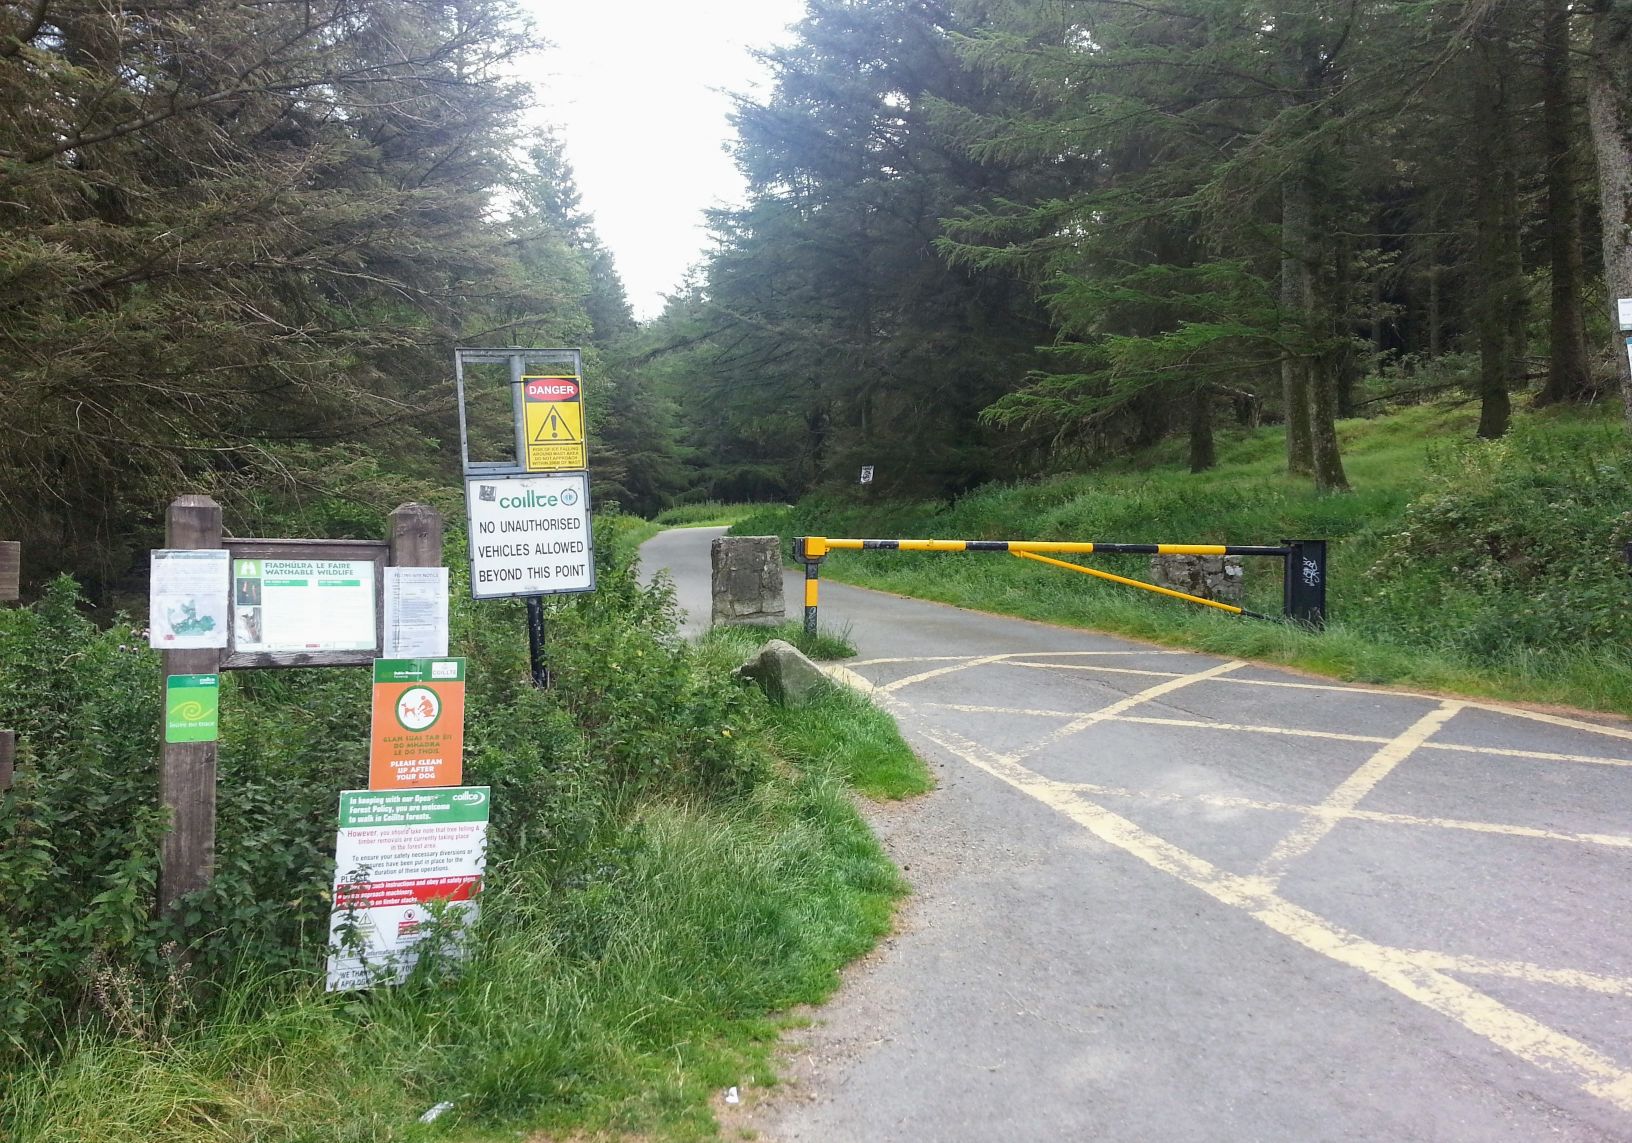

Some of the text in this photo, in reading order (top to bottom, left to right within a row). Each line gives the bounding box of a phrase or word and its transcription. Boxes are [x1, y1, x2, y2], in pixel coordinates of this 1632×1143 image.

[529, 386, 574, 395] DANGER
[500, 490, 558, 508] coillte
[479, 518, 580, 533] NO UNAUTHORISED
[478, 541, 584, 558] VEHICLES ALLOWED
[479, 564, 585, 582] BEYOND THIS POINT
